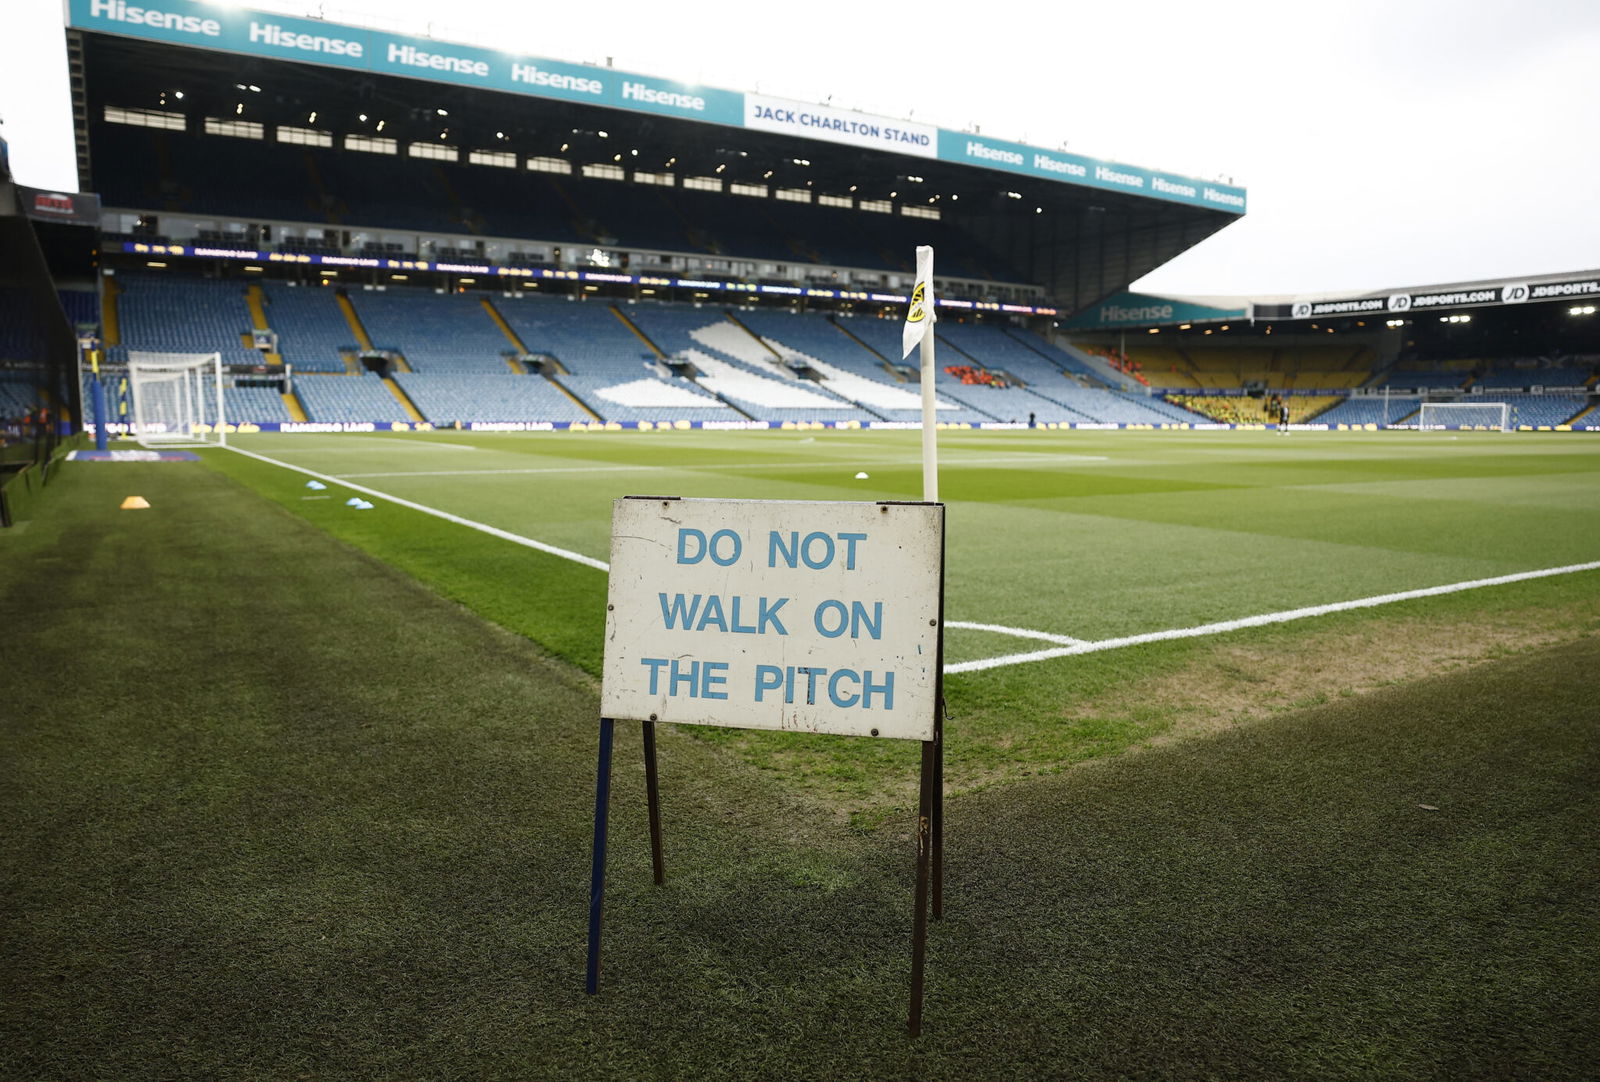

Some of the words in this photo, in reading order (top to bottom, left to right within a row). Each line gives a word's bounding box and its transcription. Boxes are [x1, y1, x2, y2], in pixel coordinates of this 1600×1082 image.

[90, 0, 221, 37] Hisense
[249, 21, 363, 58] Hisense
[387, 43, 490, 77] Hisense
[511, 62, 603, 95] Hisense
[622, 81, 706, 111] Hisense
[754, 105, 796, 124] JACK
[799, 113, 880, 138] CHARLTON
[884, 128, 930, 146] STAND
[966, 141, 1024, 166] Hisense
[1034, 154, 1086, 177] Hisense
[1095, 166, 1144, 188] Hisense
[1152, 177, 1196, 198] Hisense
[1203, 187, 1245, 208] Hisense
[1412, 290, 1496, 307] JDSPORTS.COM
[1505, 286, 1526, 300] JD
[1101, 304, 1173, 322] Hisense
[677, 528, 742, 566] DO
[768, 531, 867, 571] NOT
[658, 592, 790, 635] WALK
[814, 600, 883, 640] ON
[641, 658, 729, 700] THE
[754, 664, 895, 710] PITCH
